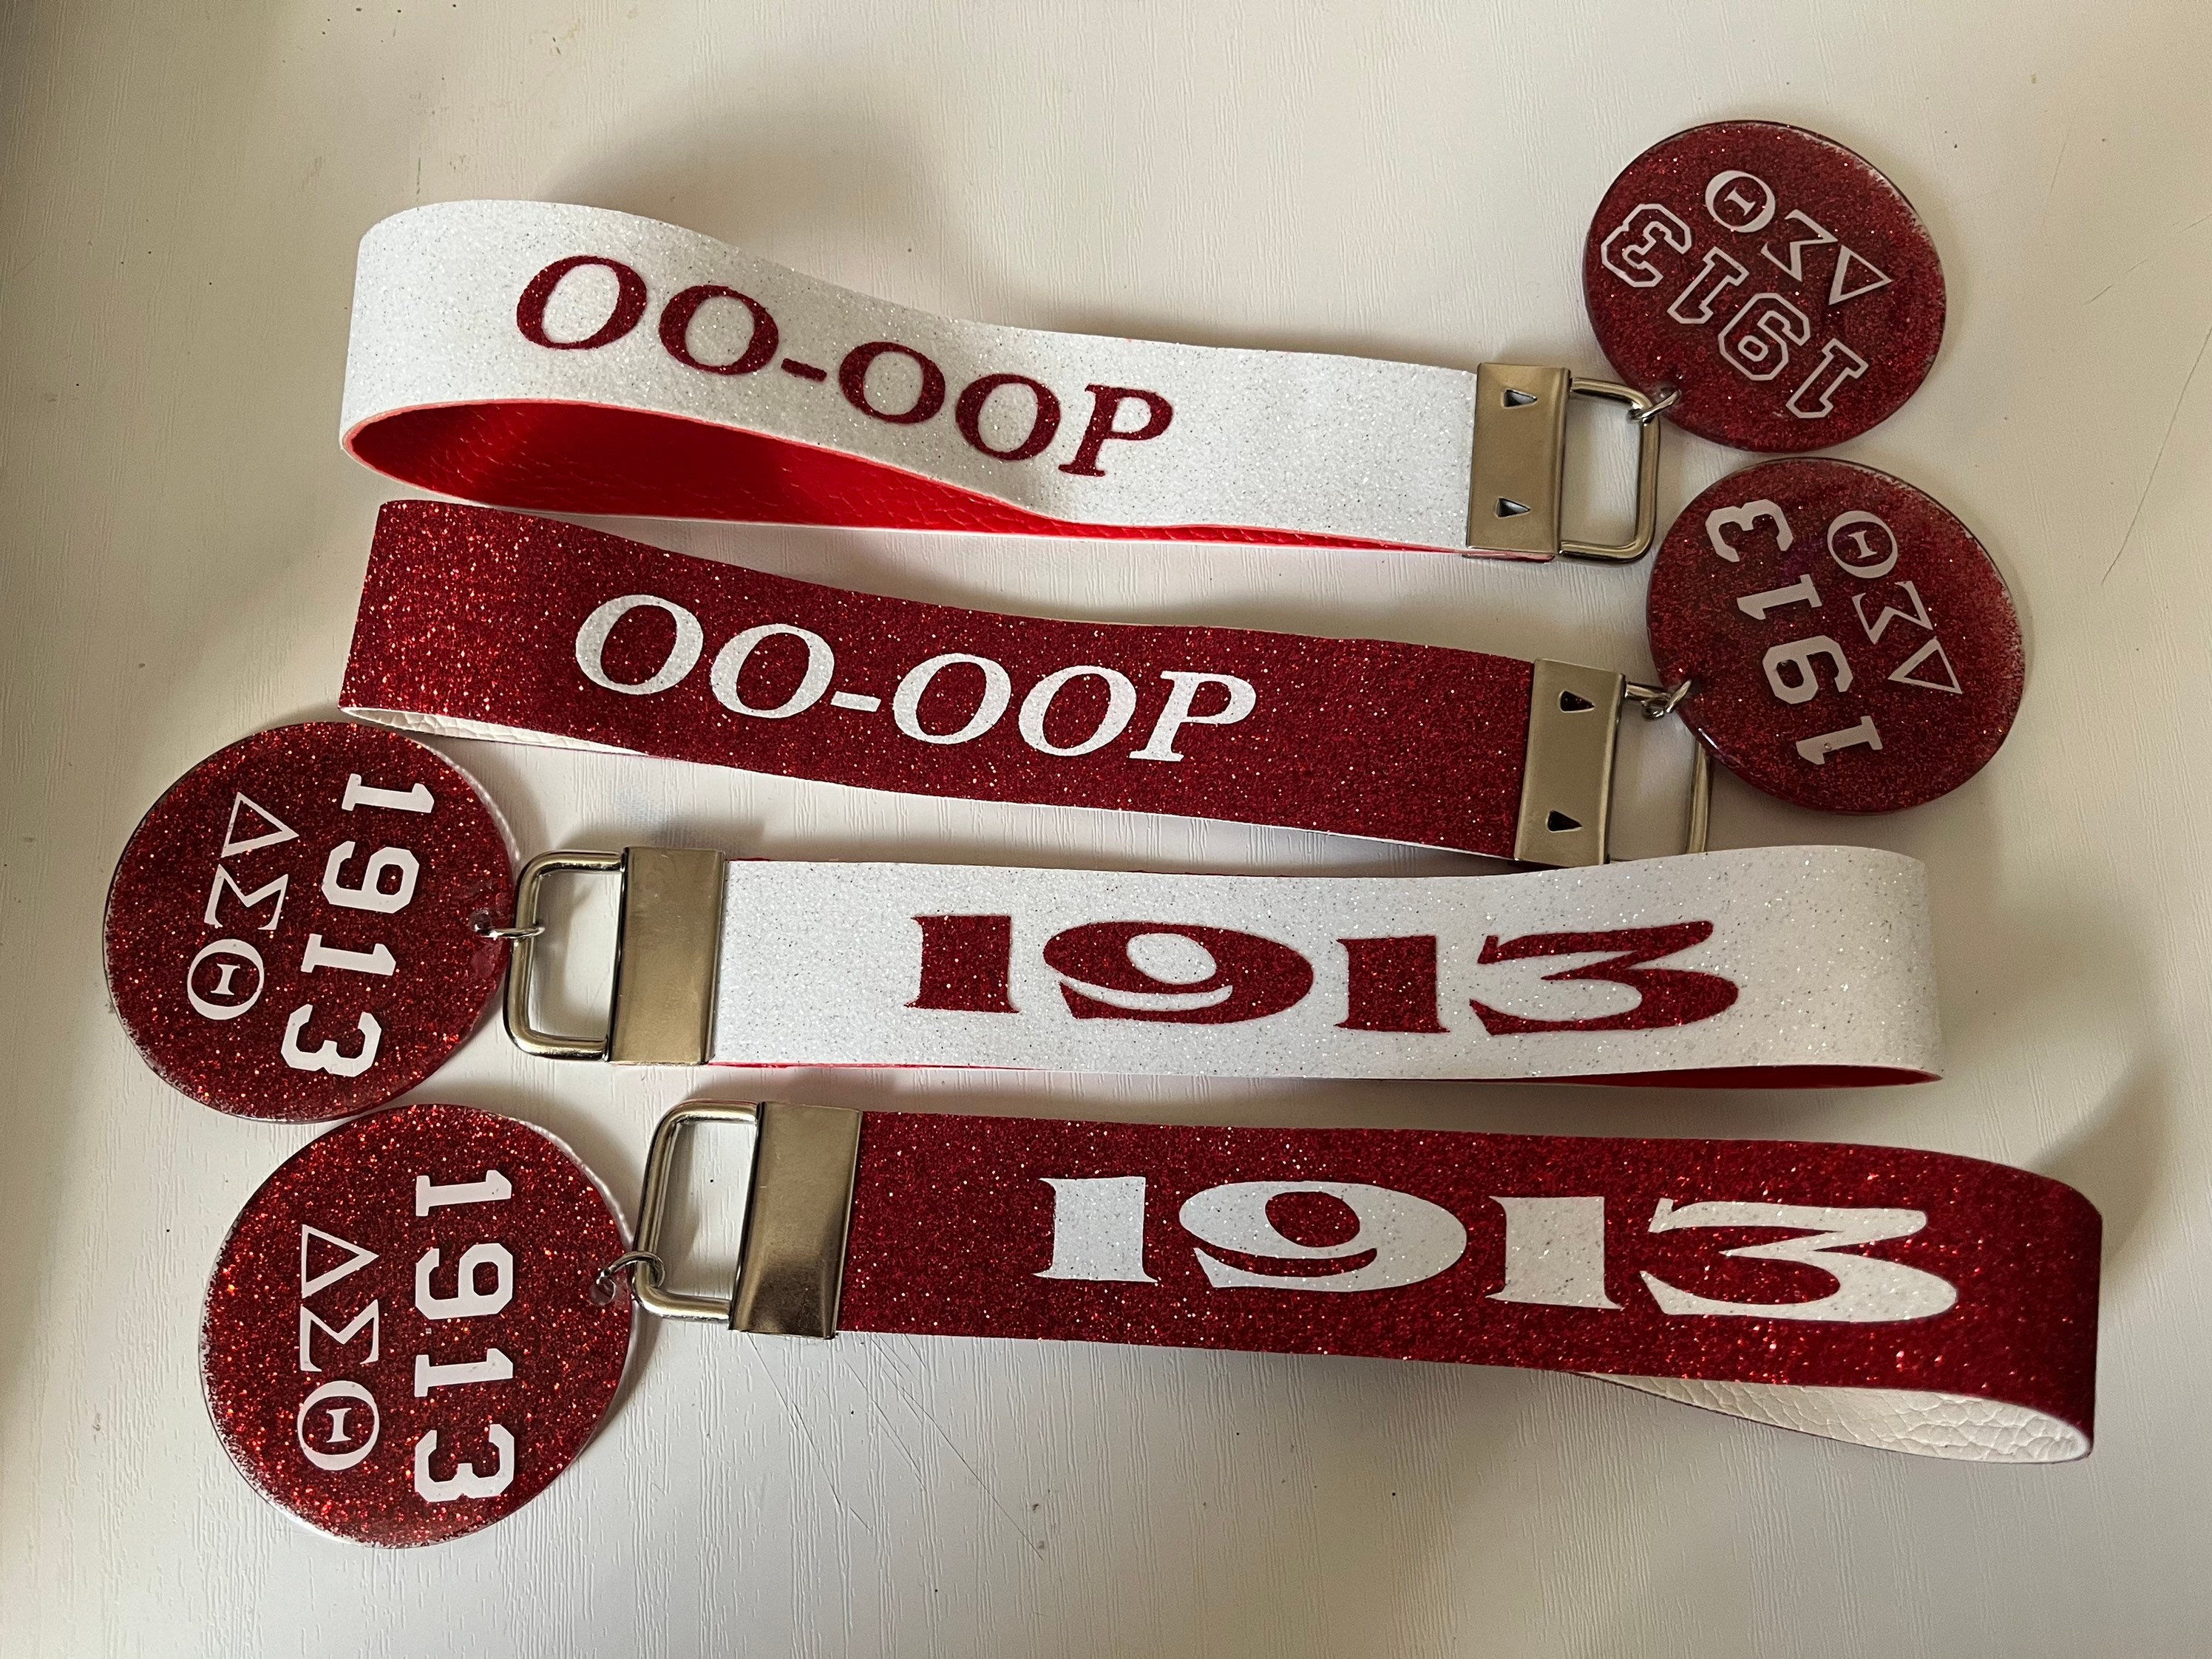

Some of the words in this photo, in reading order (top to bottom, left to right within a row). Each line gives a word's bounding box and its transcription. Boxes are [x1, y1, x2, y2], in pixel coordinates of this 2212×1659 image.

[1601, 203, 1869, 419] 1913
[1704, 169, 1891, 305] ΔΣΘ
[516, 255, 1174, 477] OO-OOP
[575, 594, 1256, 761] OO-OOP
[1705, 498, 1882, 766] 1913
[1827, 509, 1963, 694] ΔΣΘ
[187, 792, 299, 1020] ΔΣΘ
[280, 773, 435, 1077] 1913
[905, 914, 1740, 1035] 1913
[296, 1224, 380, 1471] ΔΣΘ
[414, 1170, 515, 1503] 1913
[1034, 1175, 1959, 1323] 1913
